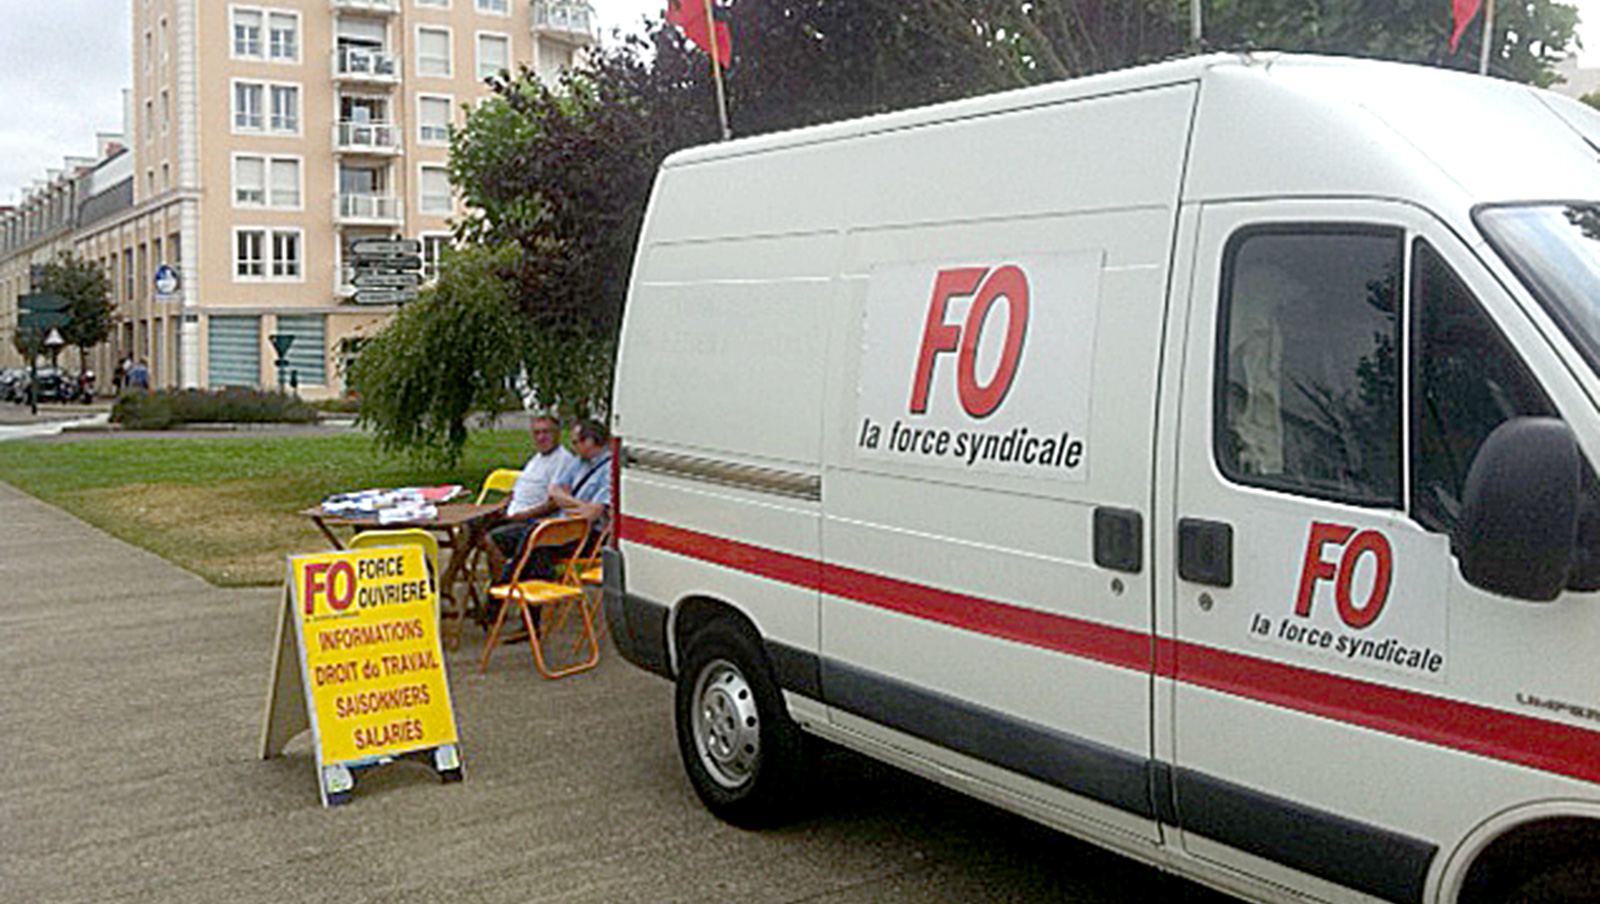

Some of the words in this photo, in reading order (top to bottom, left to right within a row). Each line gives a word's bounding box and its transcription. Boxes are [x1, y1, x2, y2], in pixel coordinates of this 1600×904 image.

[909, 265, 1030, 419] FO
[859, 418, 881, 449] la
[888, 420, 951, 456] force
[953, 427, 1083, 468] syndicale
[303, 561, 356, 615] FO
[358, 555, 404, 579] FORCE
[1294, 521, 1393, 628] FO
[318, 619, 424, 650] INFORMATIONS
[1251, 613, 1270, 635] la
[1278, 618, 1333, 649] force
[1335, 633, 1443, 673] syndicale
[315, 661, 358, 686] DROIT
[381, 650, 440, 677] TRAVAIL
[335, 684, 431, 718] SAISONNIERS
